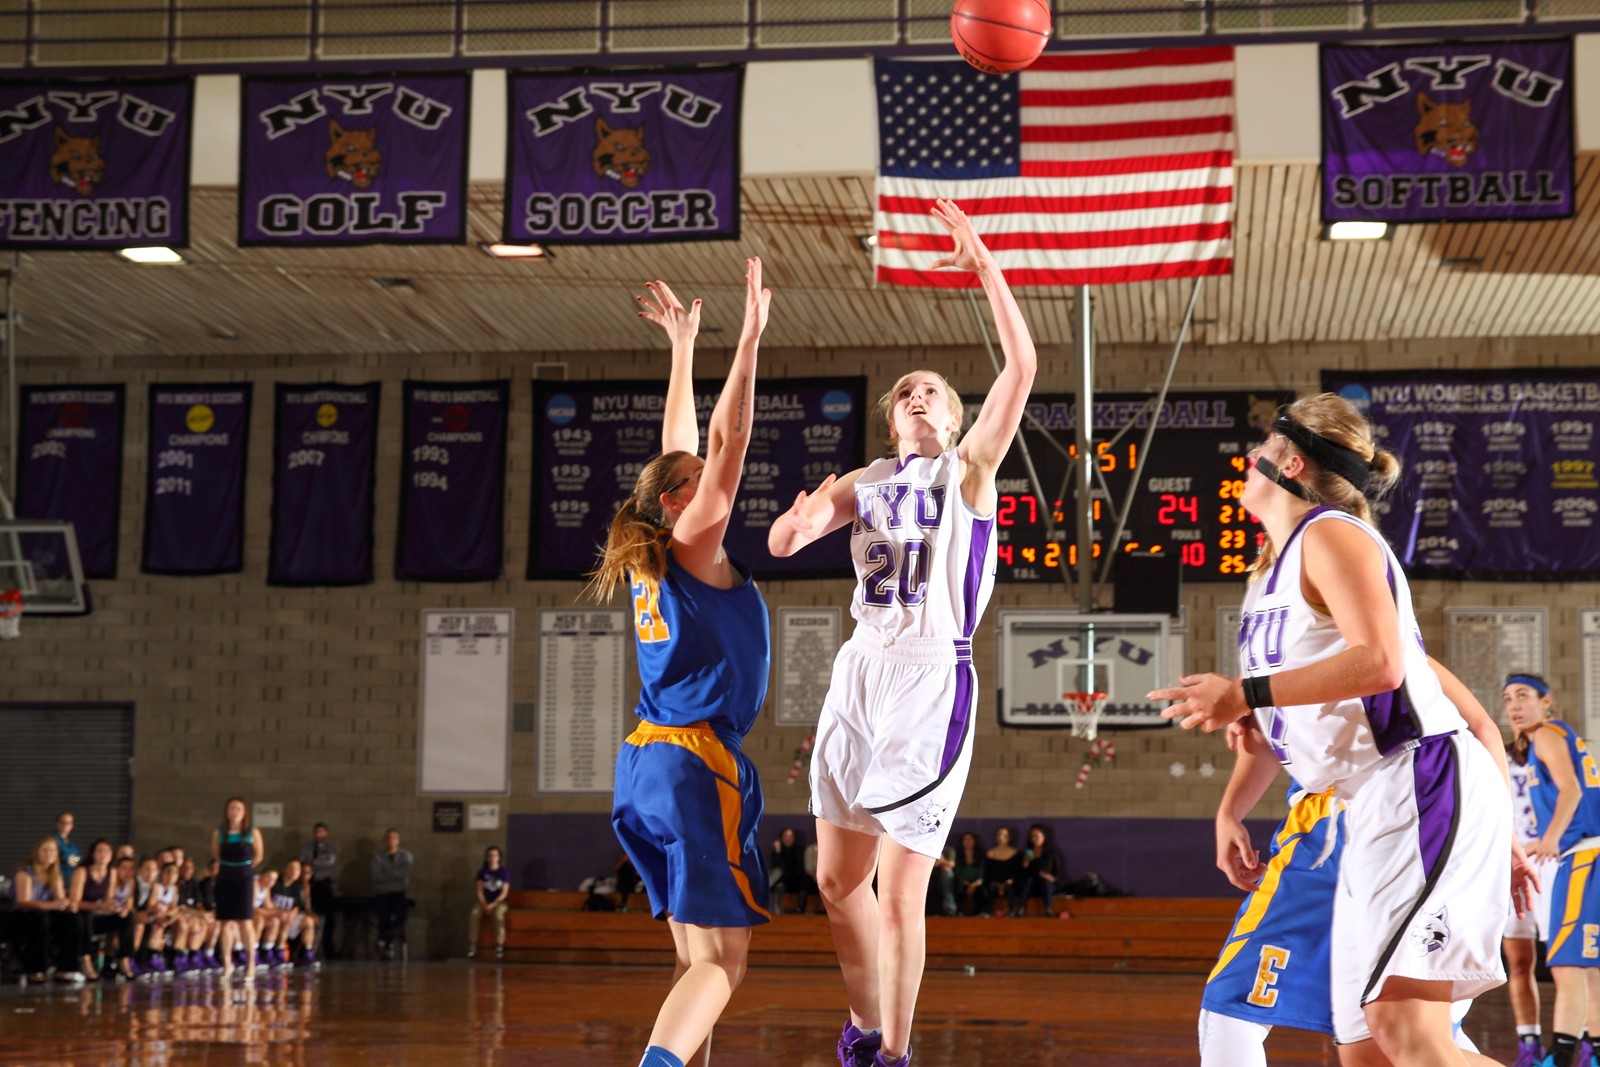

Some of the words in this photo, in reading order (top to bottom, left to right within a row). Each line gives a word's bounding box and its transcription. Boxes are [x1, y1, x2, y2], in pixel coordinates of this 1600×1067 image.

[1332, 55, 1563, 119] NYU
[0, 91, 175, 143] NYU
[260, 83, 452, 139] NYU
[526, 82, 721, 137] NYU
[1333, 170, 1563, 209] SOFTBALL
[258, 191, 446, 235] GOLF
[526, 189, 718, 234] SOCCER
[593, 394, 629, 411] NYU
[1371, 386, 1411, 403] NYU
[1413, 384, 1505, 402] WOMEN'S
[1508, 382, 1600, 401] BASKETB
[1026, 401, 1235, 429] BAKETBALL
[1148, 477, 1192, 492] GUEST
[1551, 459, 1595, 474] 1997
[853, 483, 947, 535] NYU
[998, 496, 1037, 525] 27
[1158, 494, 1198, 525] 24
[1219, 504, 1245, 524] 21
[1181, 542, 1206, 567] 10
[1219, 529, 1246, 549] 23
[862, 539, 932, 608] 20
[1219, 555, 1246, 574] 25
[631, 570, 670, 643] 21
[1583, 924, 1600, 958] E
[1247, 944, 1290, 1008] E
